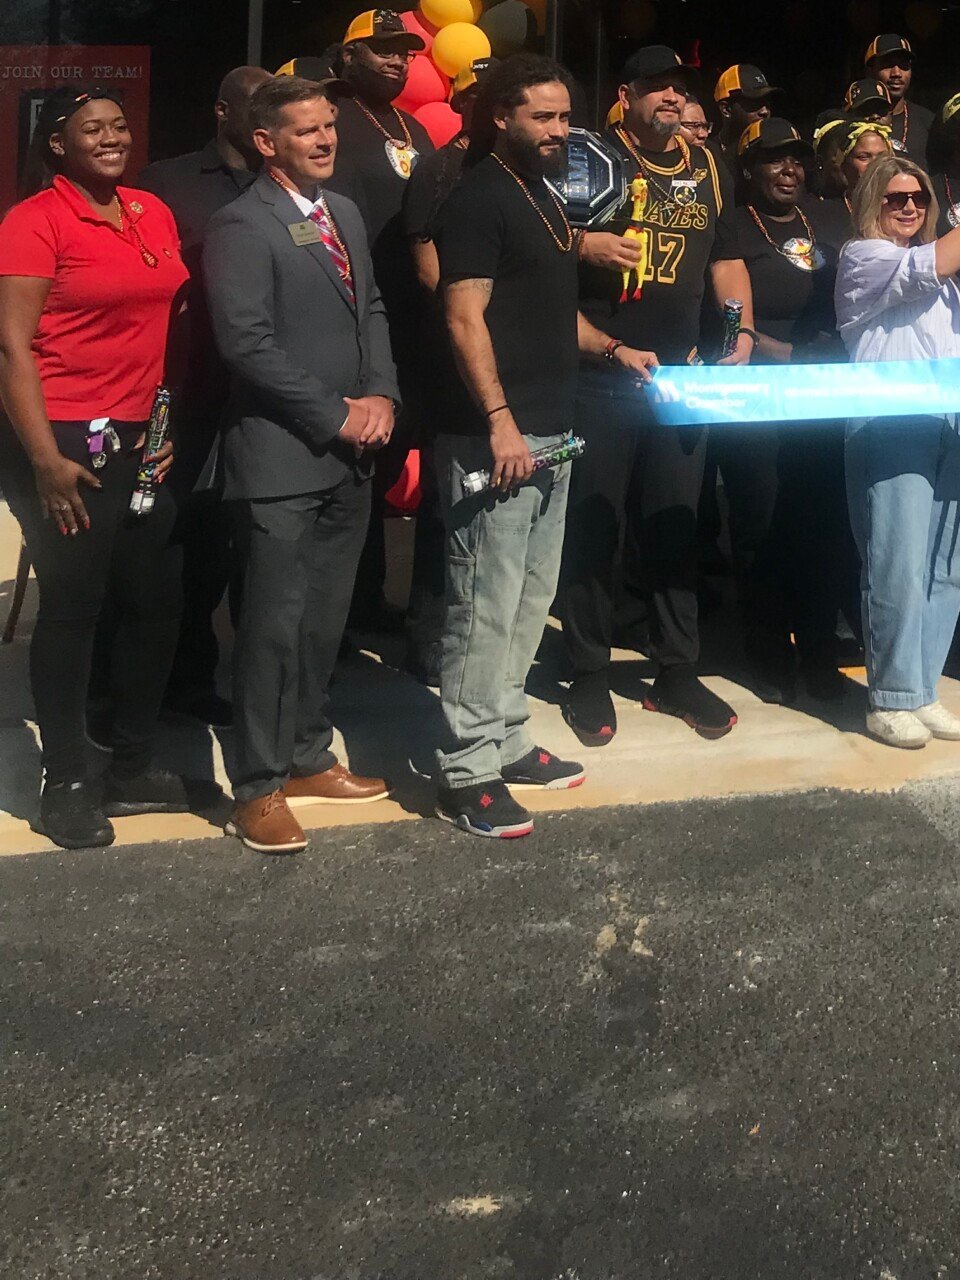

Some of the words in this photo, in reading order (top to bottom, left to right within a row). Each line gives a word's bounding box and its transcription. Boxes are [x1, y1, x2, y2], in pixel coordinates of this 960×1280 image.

[2, 66, 42, 79] JOIN
[50, 66, 83, 79] OUR
[92, 66, 143, 79] TEAM!
[643, 199, 709, 231] AVE'S
